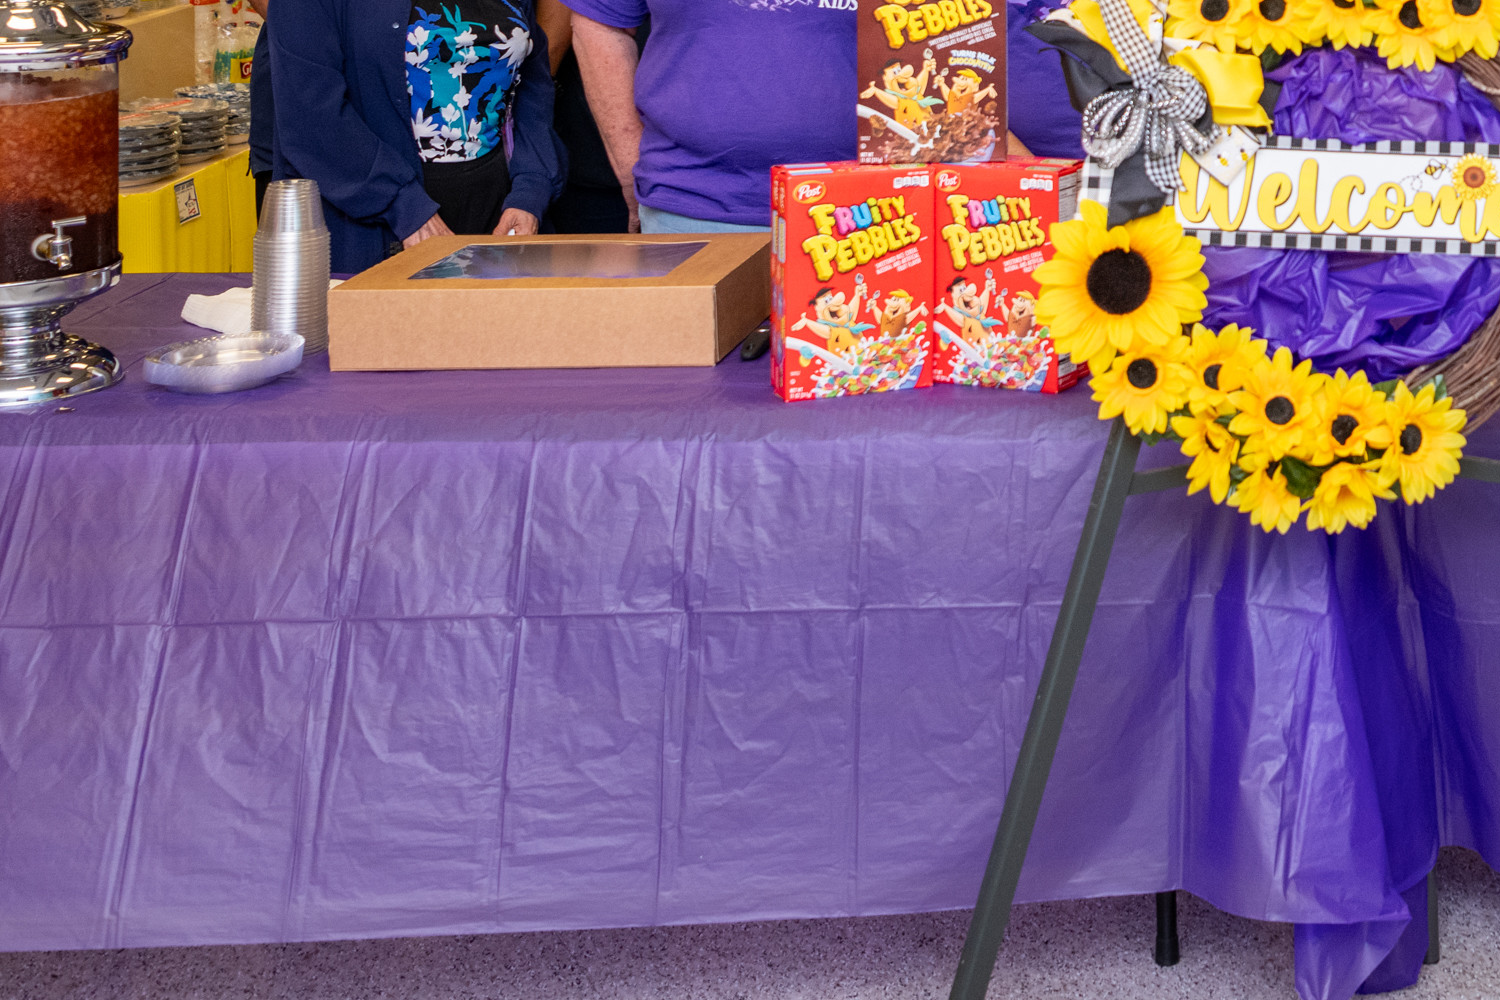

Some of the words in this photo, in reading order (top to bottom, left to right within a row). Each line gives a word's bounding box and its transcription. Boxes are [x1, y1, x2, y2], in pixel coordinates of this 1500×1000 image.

[798, 184, 822, 201] Post
[938, 173, 958, 188] Post
[808, 195, 906, 236] FRUITY
[946, 194, 1032, 228] FRUITY
[802, 214, 921, 282] PEBBLES
[941, 217, 1046, 271] PEBBLES
